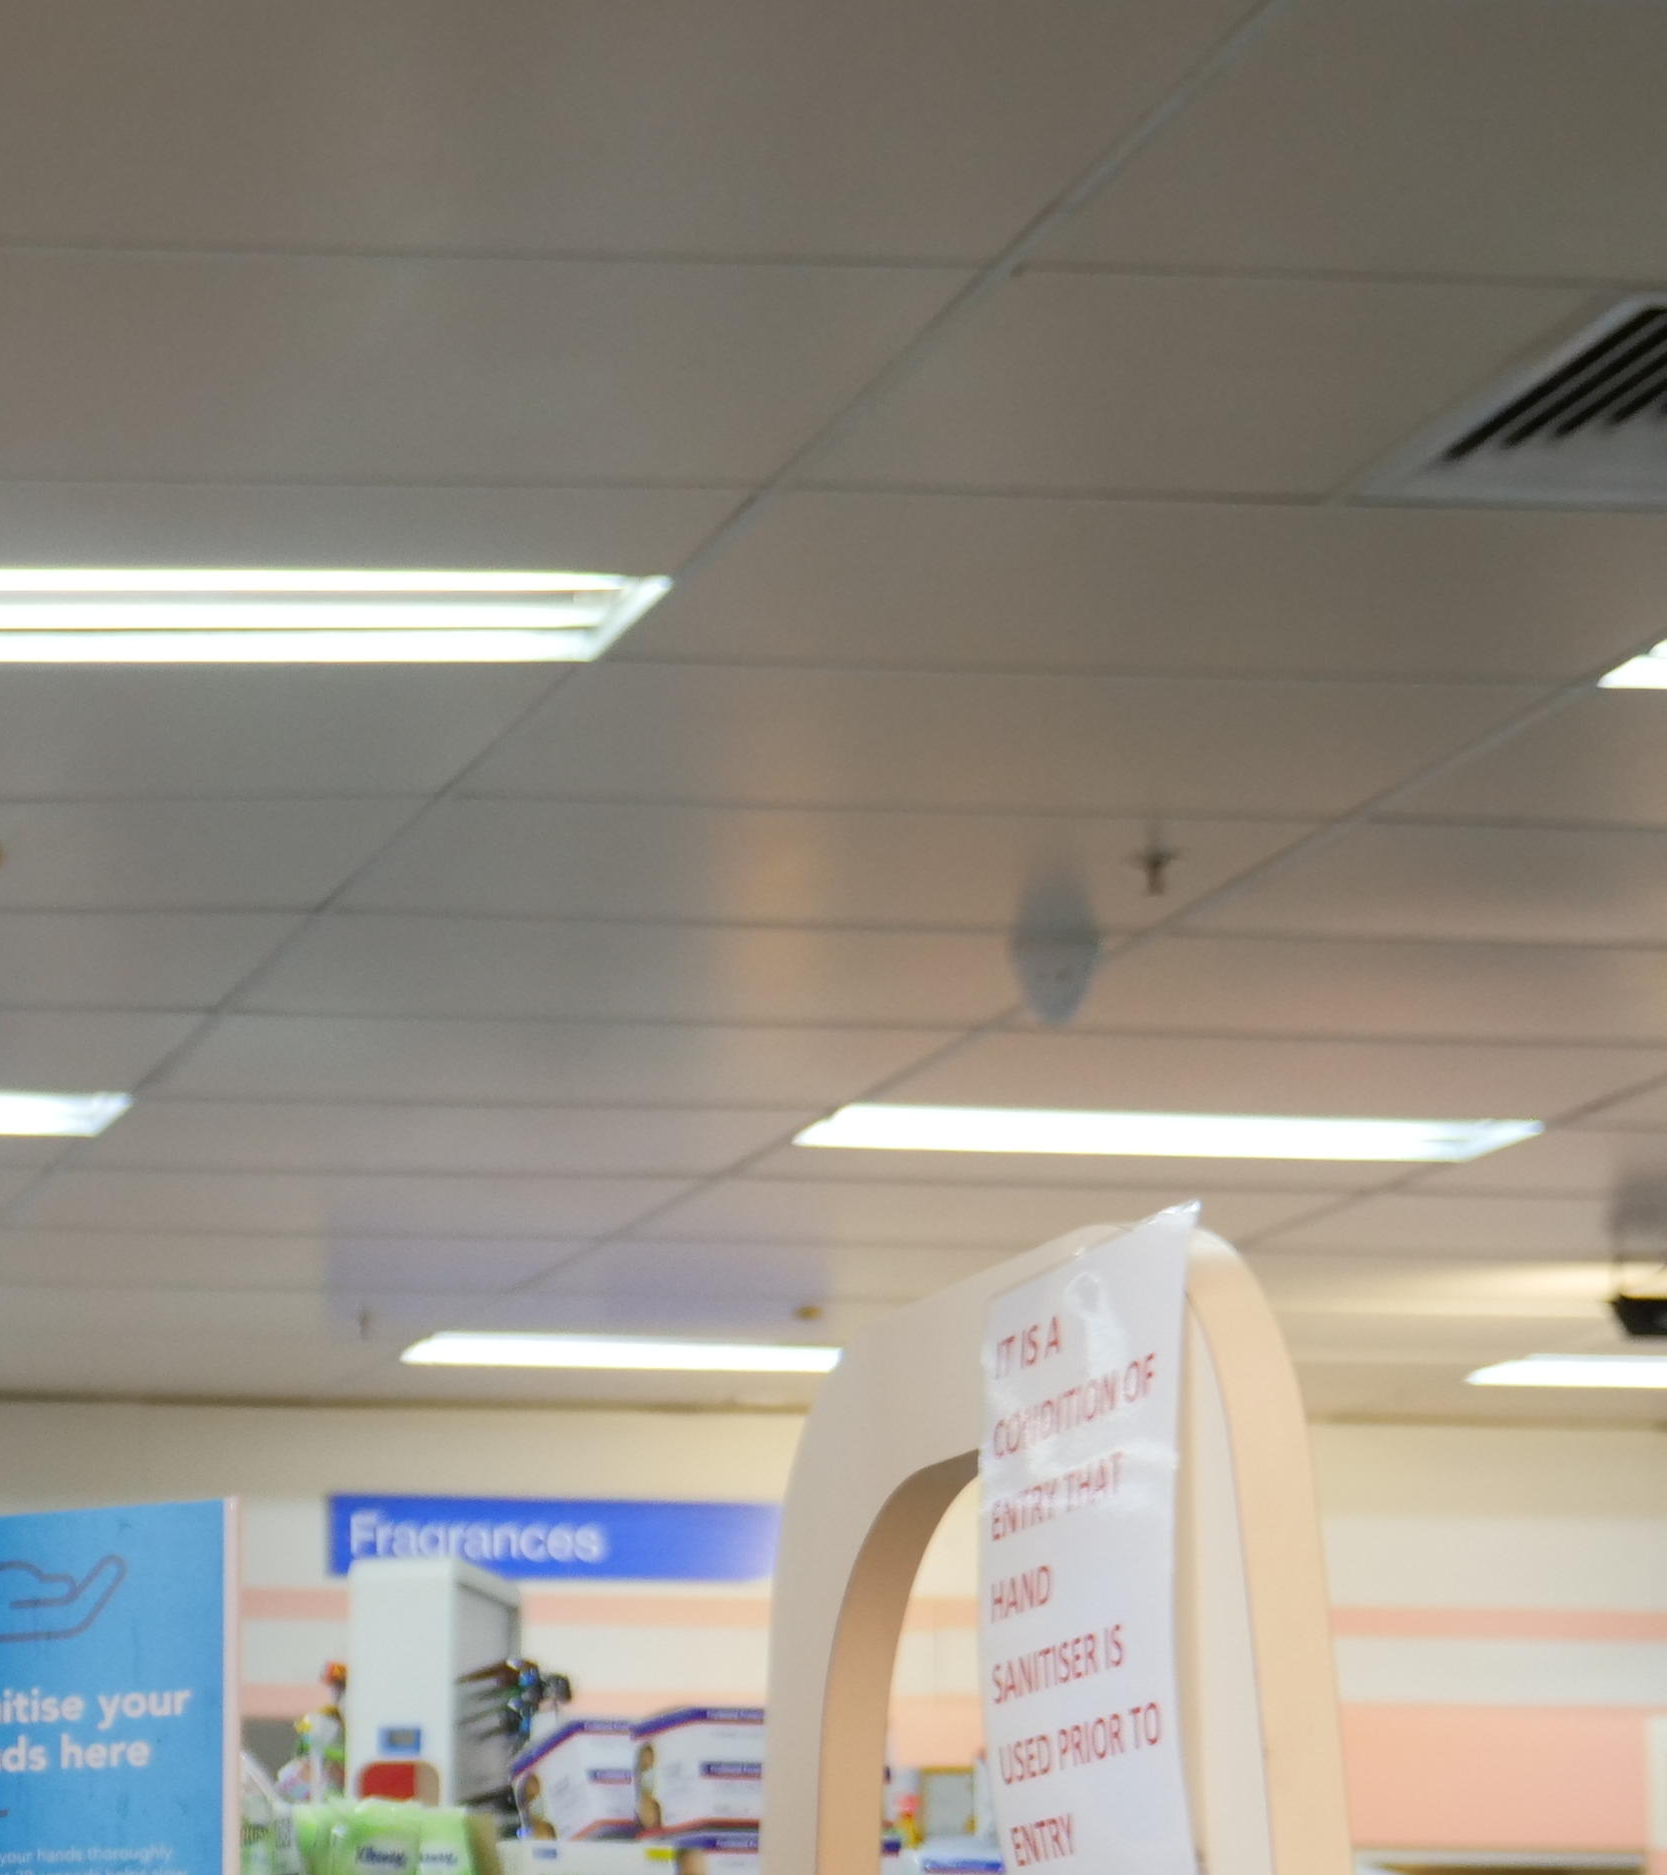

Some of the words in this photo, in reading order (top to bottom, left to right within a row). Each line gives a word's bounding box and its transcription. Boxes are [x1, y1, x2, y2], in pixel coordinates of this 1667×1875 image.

[995, 1335, 1016, 1380] IT
[1021, 1323, 1039, 1370] IS
[1044, 1315, 1061, 1360] A
[993, 1368, 1119, 1459] CONDITION
[1124, 1351, 1157, 1403] OF
[992, 1478, 1058, 1541] ENTRY
[1064, 1450, 1124, 1512] THAT
[348, 1510, 608, 1563] Fragrances
[990, 1564, 1052, 1624] HAND
[991, 1632, 1099, 1704] SANITISER
[1105, 1623, 1125, 1671] IS
[97, 1689, 192, 1731] your
[60, 1731, 152, 1770] here
[997, 1733, 1052, 1785] USED
[1058, 1712, 1125, 1771] PRIOR
[1129, 1701, 1162, 1751] TO
[0, 1852, 33, 1867] your
[37, 1848, 83, 1864] hands
[87, 1846, 174, 1863] thoroughly
[1010, 1813, 1075, 1867] ENTRY
